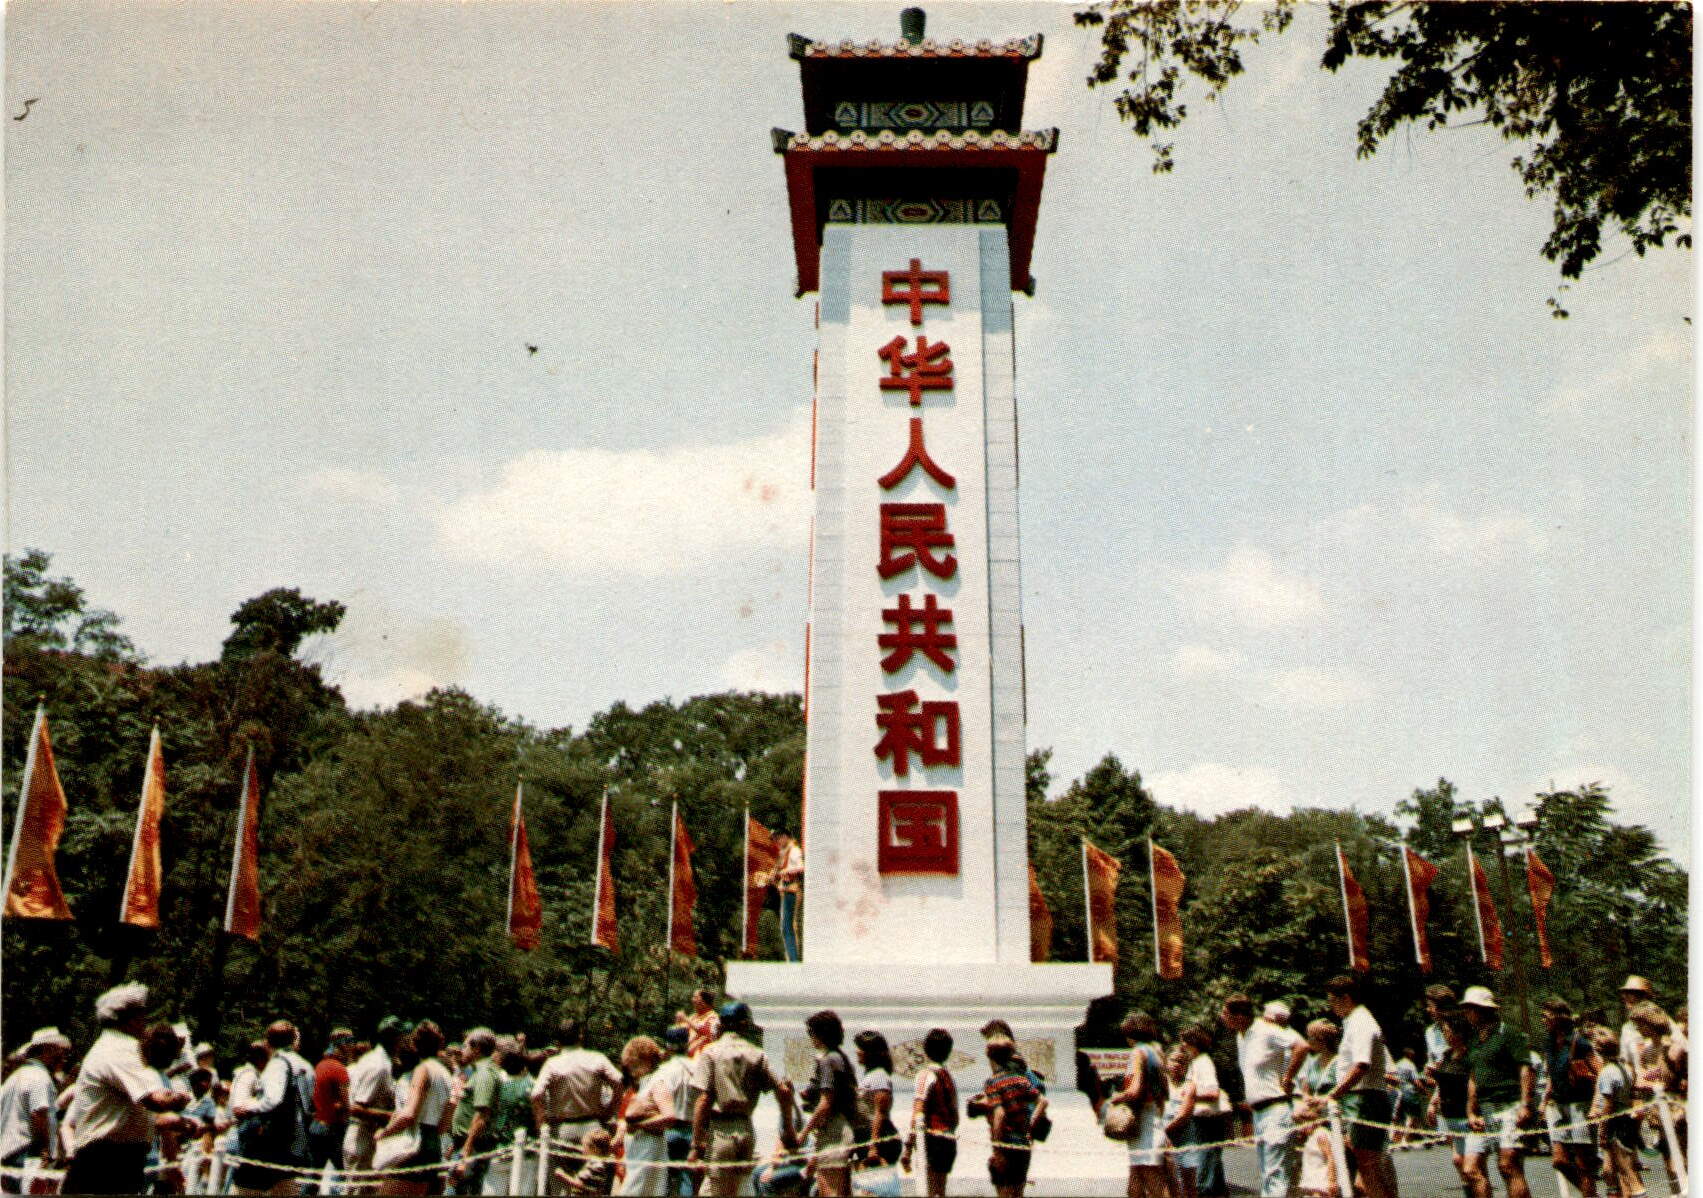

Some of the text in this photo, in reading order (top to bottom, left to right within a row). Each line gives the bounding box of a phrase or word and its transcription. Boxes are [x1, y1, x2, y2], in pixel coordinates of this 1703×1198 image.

[874, 258, 961, 875] 中华人民共和国
